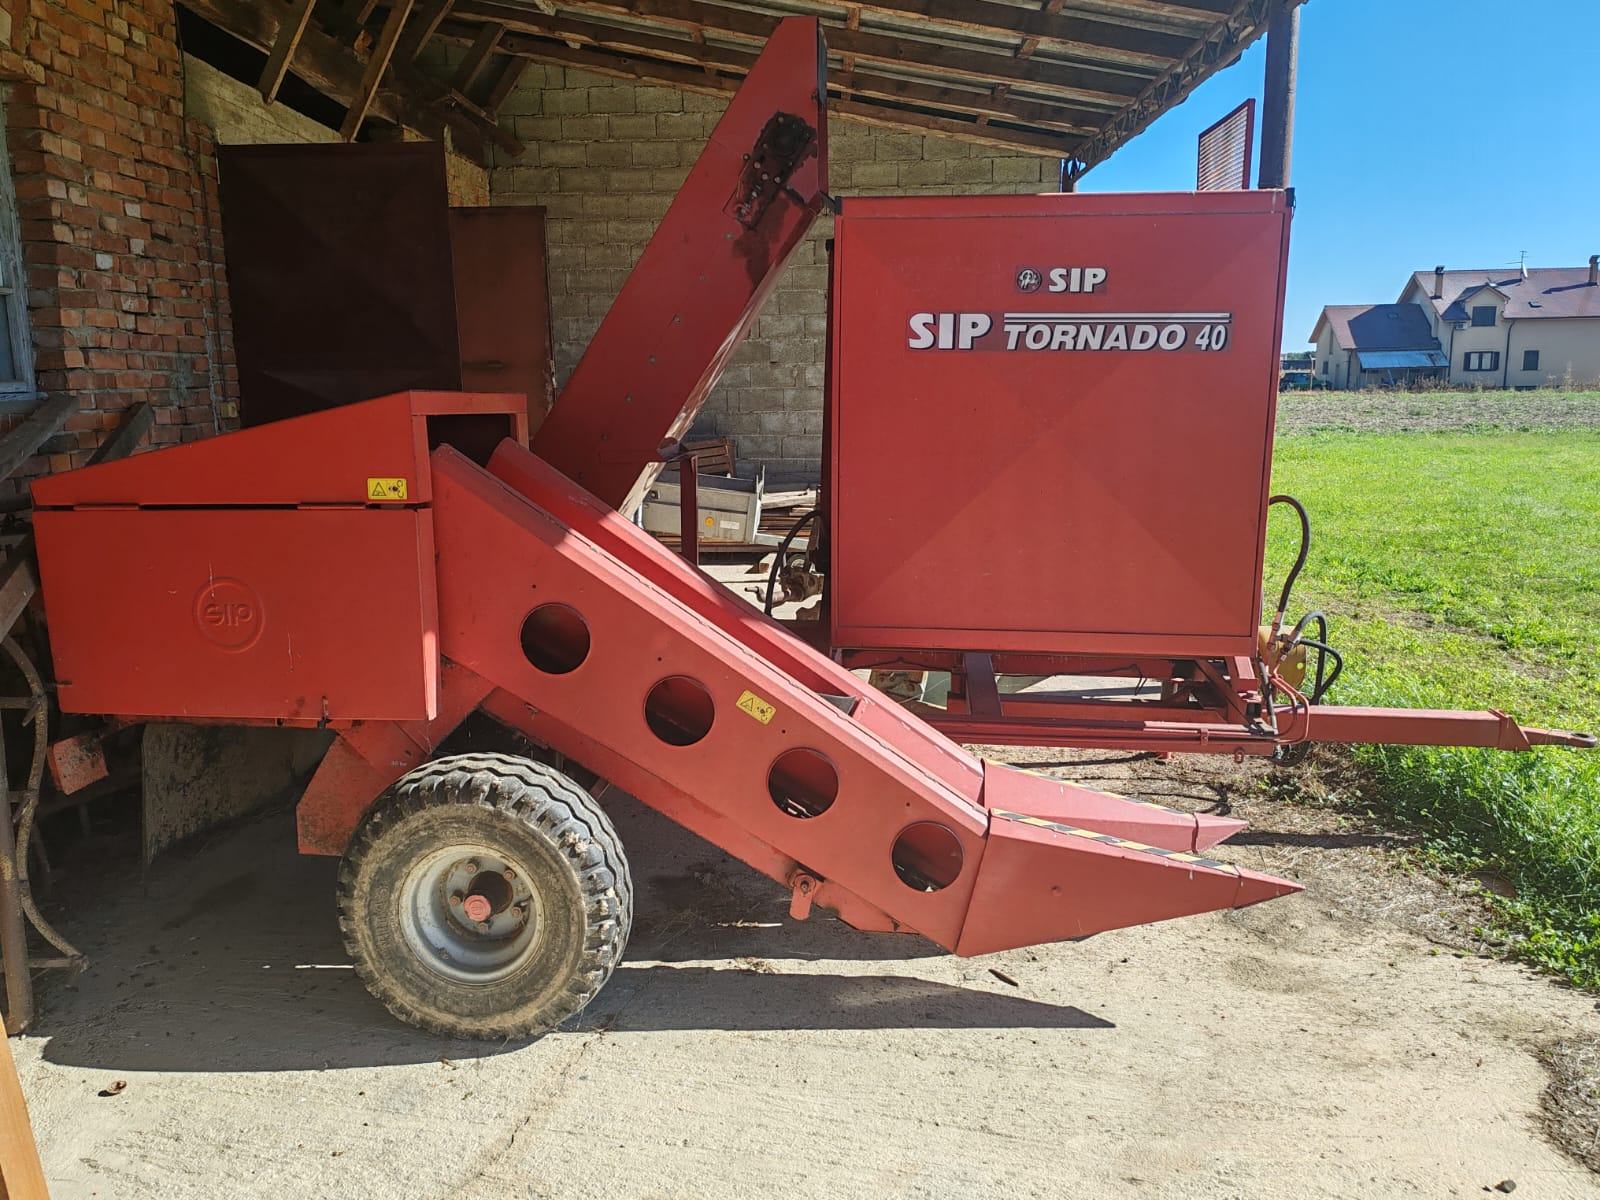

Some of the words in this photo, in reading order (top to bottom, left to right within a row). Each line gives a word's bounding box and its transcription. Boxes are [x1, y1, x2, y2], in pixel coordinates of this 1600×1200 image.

[1048, 267, 1107, 292] SIP
[908, 313, 992, 350] SIP
[1004, 324, 1187, 350] TORNADO
[1195, 324, 1227, 350] 40
